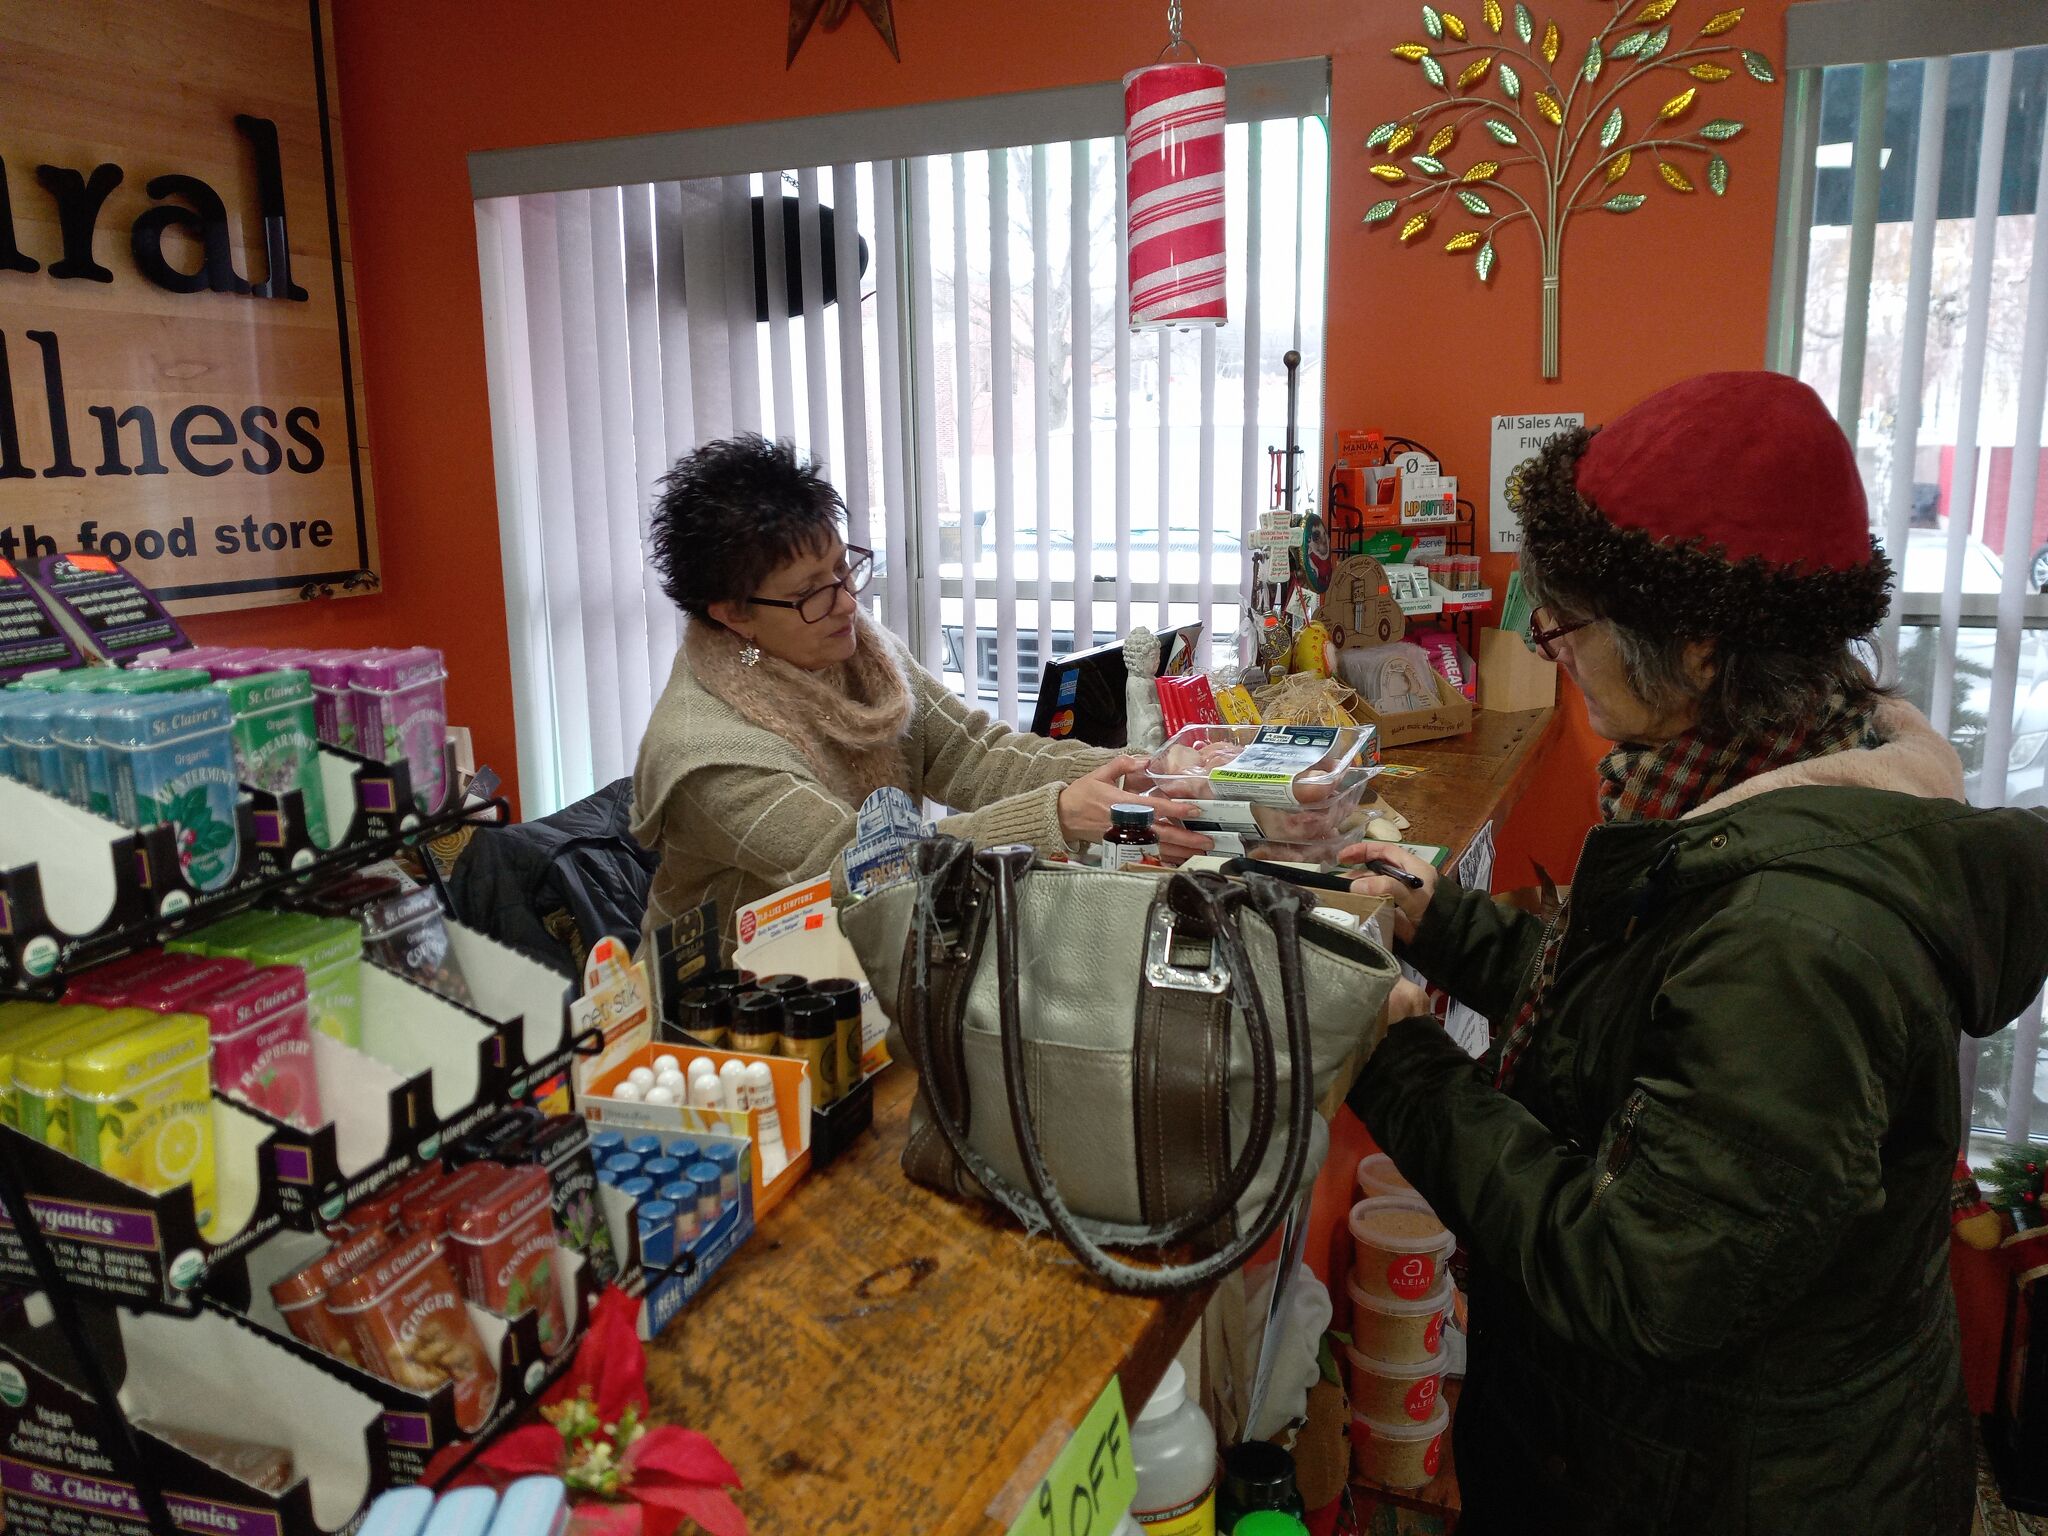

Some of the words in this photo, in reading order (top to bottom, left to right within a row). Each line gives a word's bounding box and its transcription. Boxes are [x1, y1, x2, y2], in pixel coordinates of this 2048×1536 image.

[1497, 418, 1514, 430] All
[1517, 417, 1550, 430] Sales
[1554, 416, 1577, 428] Are
[1343, 442, 1379, 453] MANUKA
[1520, 437, 1552, 449] FINA
[1405, 501, 1420, 518] LIP
[1420, 499, 1455, 516] BUTTER
[77, 516, 198, 563] food
[215, 513, 334, 556] store
[1418, 540, 1443, 548] eserve
[152, 720, 169, 735] St.
[172, 708, 219, 729] Claire's
[174, 748, 211, 766] Organic
[237, 1004, 253, 1024] St.
[254, 986, 298, 1015] Claire's
[256, 1024, 290, 1047] Organic
[240, 1040, 310, 1088] RASPBERRY
[442, 1102, 497, 1144] Allergen-free
[346, 1153, 411, 1203] Allergen-free
[400, 1293, 456, 1342] GINGER
[30, 1472, 58, 1496] St.
[61, 1477, 142, 1511] Claire's
[166, 1500, 241, 1532] ganics
[1156, 1511, 1171, 1522] BEE
